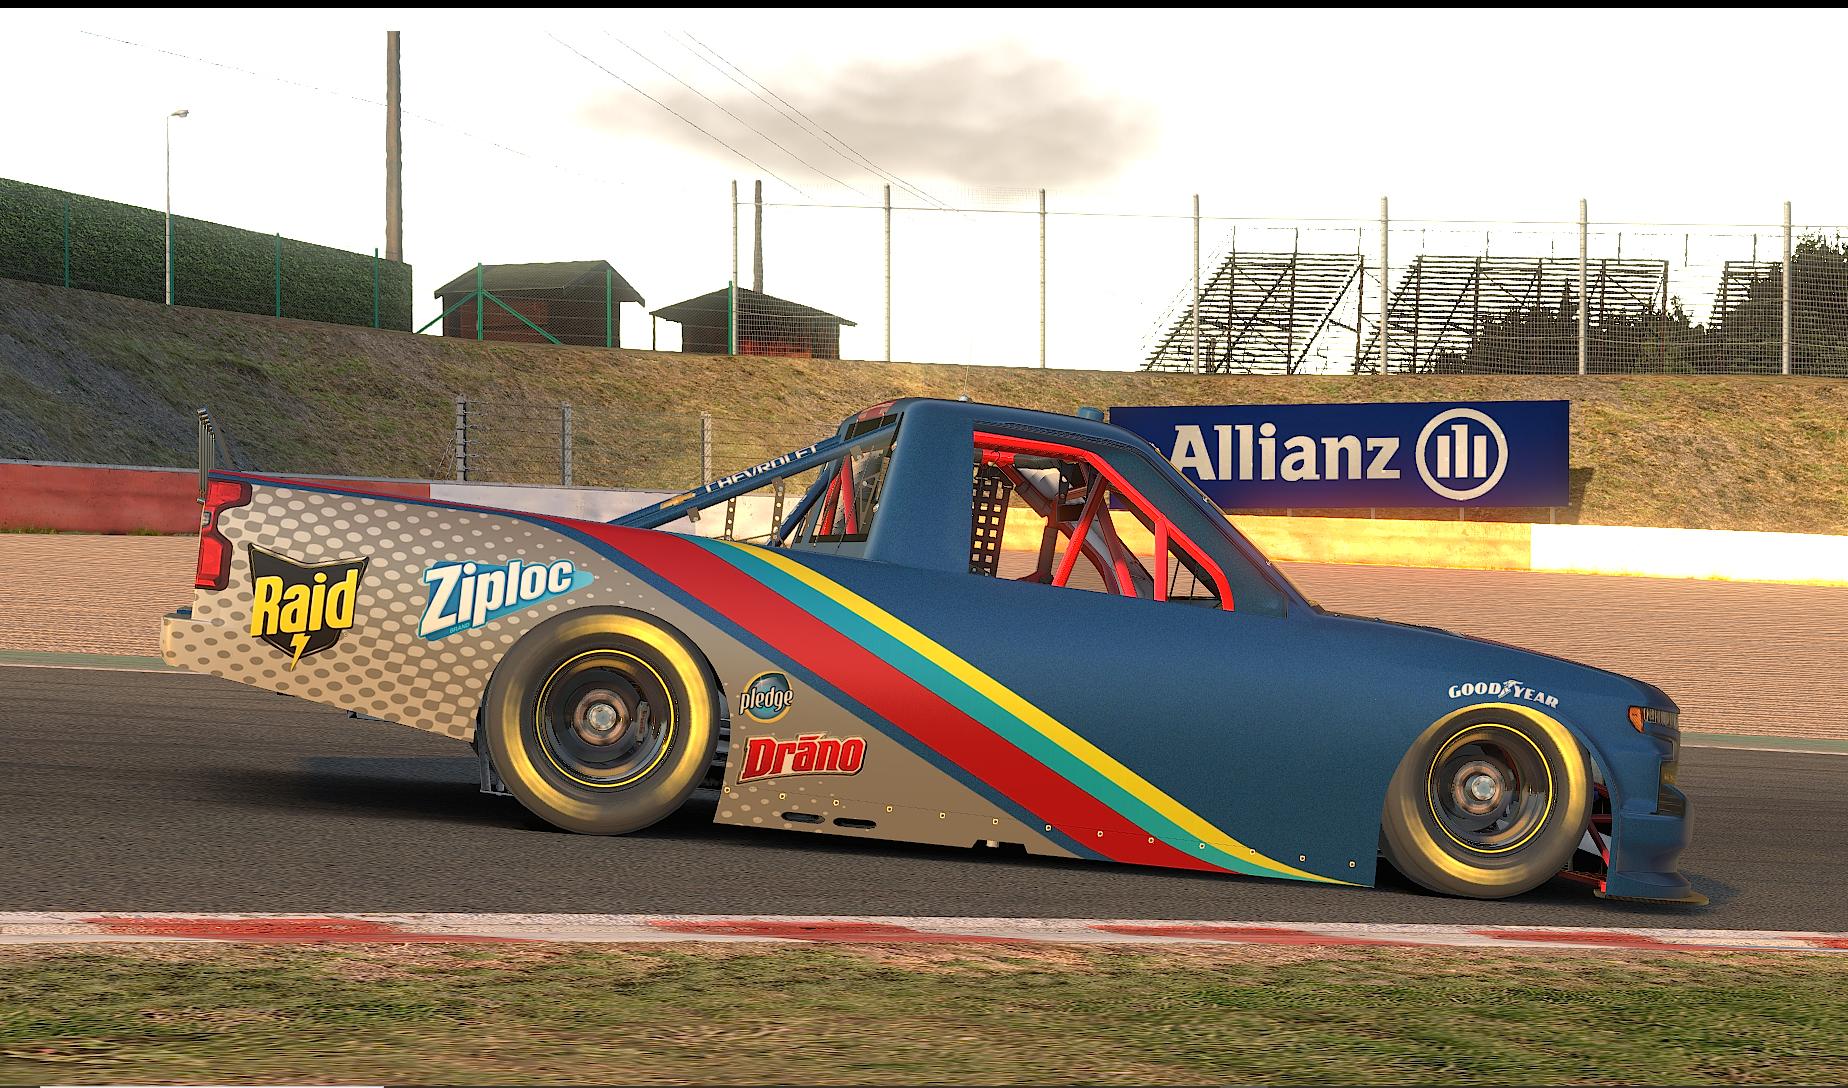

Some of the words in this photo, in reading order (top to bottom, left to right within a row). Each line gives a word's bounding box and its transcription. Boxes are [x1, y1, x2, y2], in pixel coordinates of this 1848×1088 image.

[705, 443, 818, 493] CHEVROLET
[1170, 423, 1401, 482] Allianz
[250, 568, 359, 637] Raid
[419, 560, 573, 637] Ziploc
[449, 622, 471, 634] BRAND
[740, 686, 794, 715] pledge
